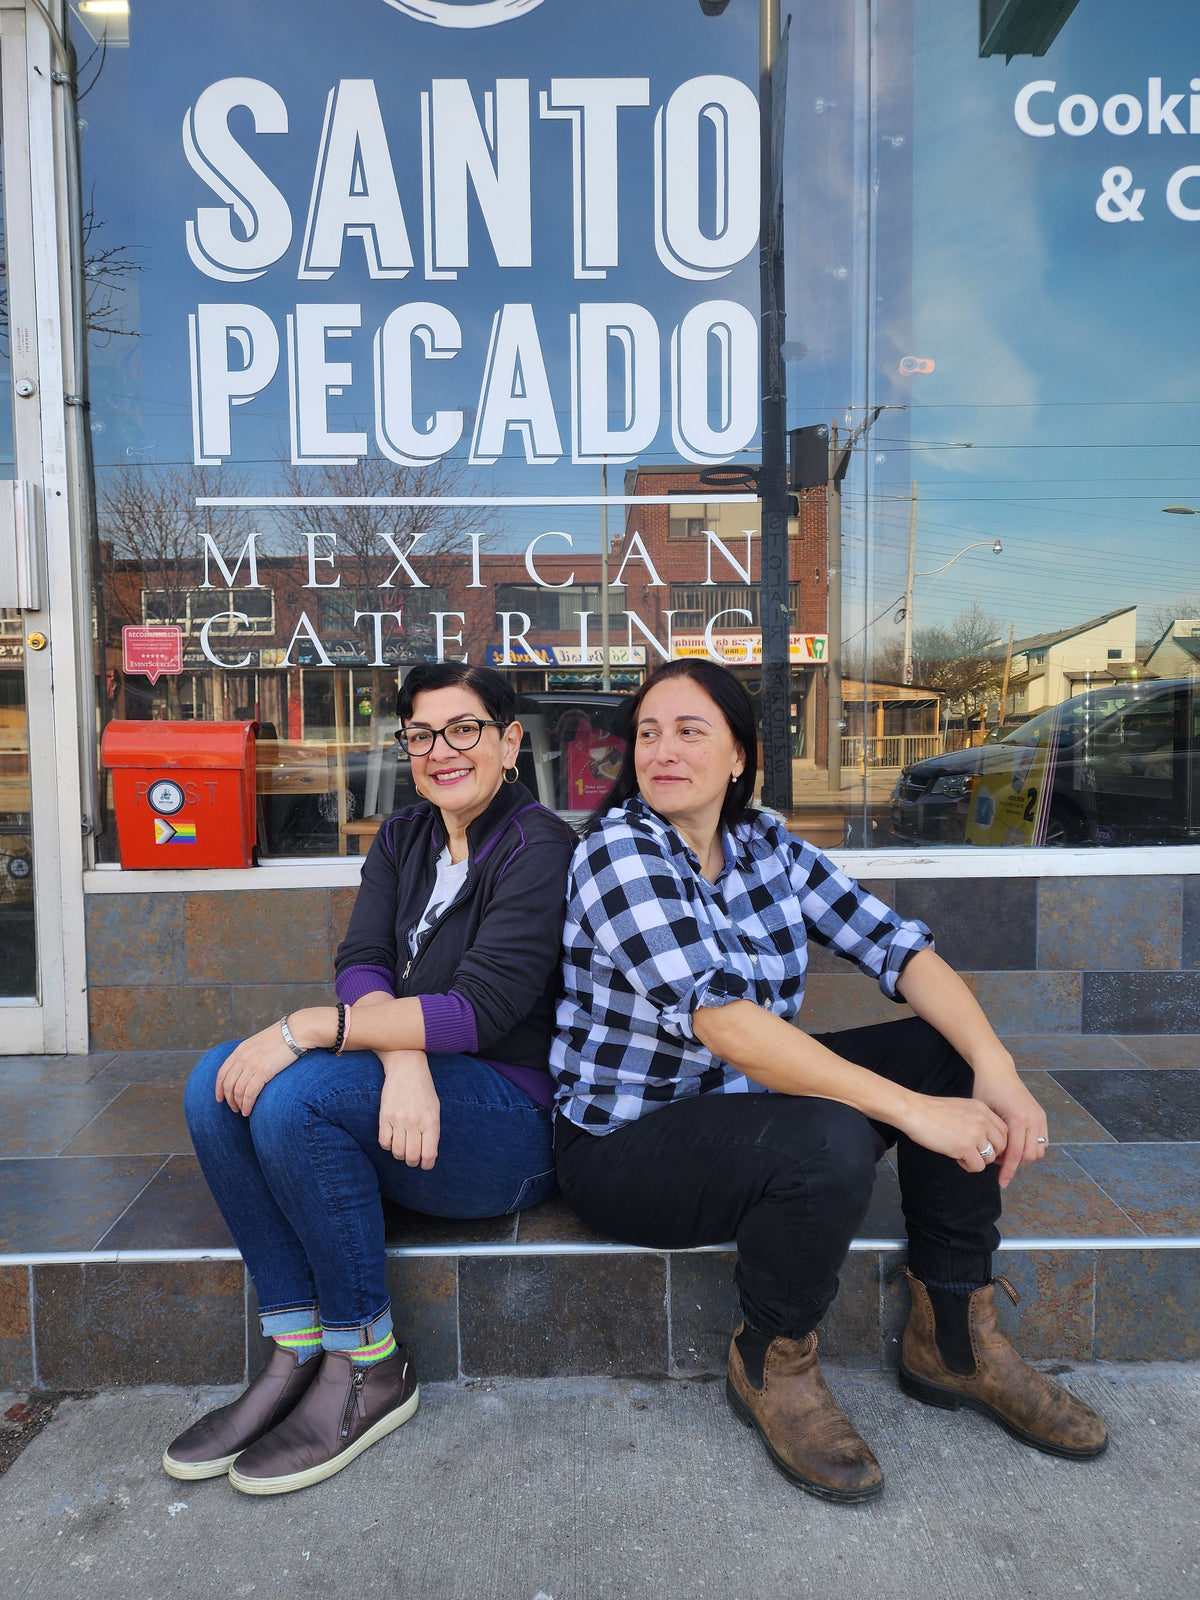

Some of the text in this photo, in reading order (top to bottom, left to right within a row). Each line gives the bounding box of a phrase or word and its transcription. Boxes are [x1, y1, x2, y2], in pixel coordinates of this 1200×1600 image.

[1014, 77, 1200, 137] Cooki
[182, 74, 760, 282] SANTO
[1095, 164, 1200, 223] & C
[188, 299, 760, 468] PECADO
[197, 529, 758, 588] MEXICAN
[200, 608, 762, 667] CATERING
[135, 781, 218, 805] PST
[1024, 787, 1037, 822] 2
